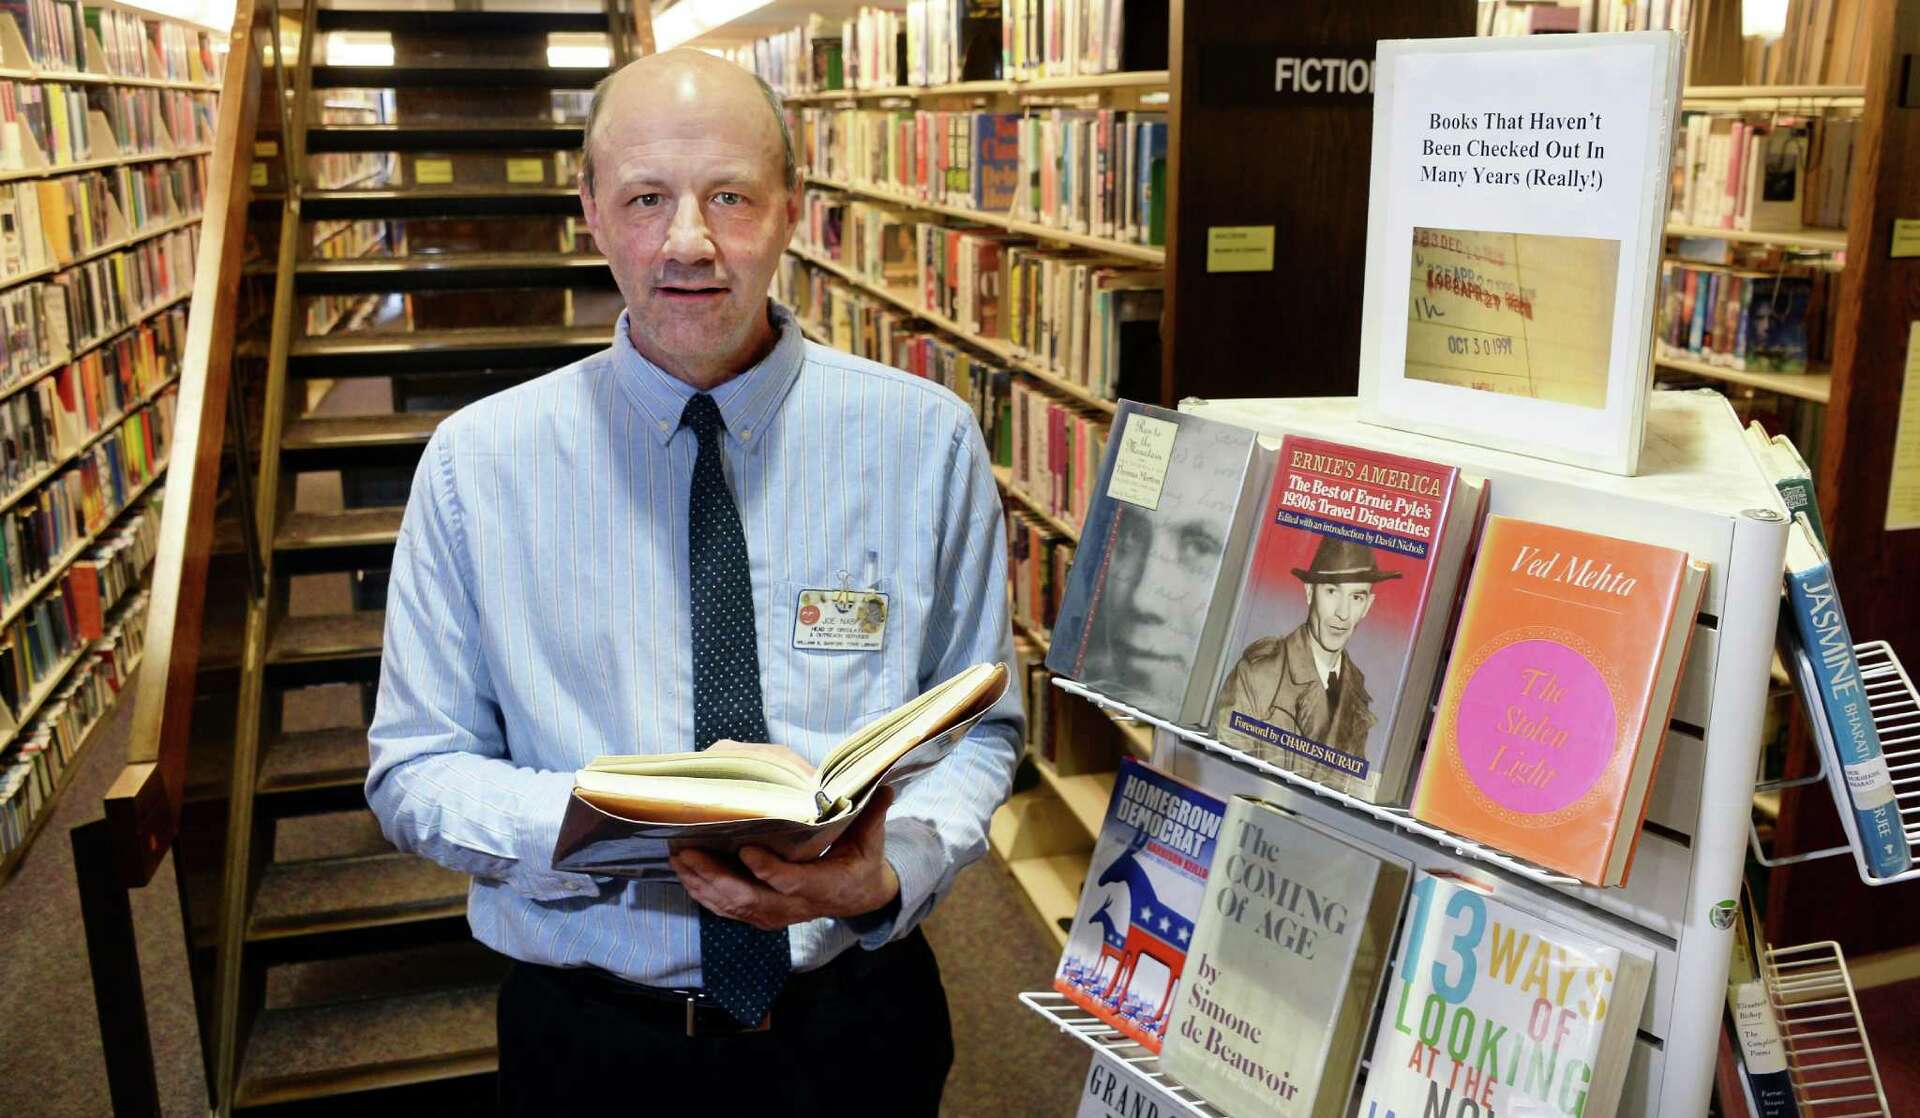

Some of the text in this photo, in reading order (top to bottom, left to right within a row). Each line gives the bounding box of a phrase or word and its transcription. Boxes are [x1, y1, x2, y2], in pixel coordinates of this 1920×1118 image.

[1430, 112, 1602, 130] Books That Haven’t
[1423, 139, 1604, 159] Been Checked Out In
[1420, 166, 1603, 192] Many Years (Really!)
[1448, 335, 1470, 355] OCT
[1289, 475, 1433, 522] The Best of Ernie Pyle’s
[1290, 451, 1441, 497] ERNIE’S AMERICA
[1277, 512, 1425, 555] Edited with an introduction by David Nichols
[1281, 491, 1430, 538] 1930s Travel Dispatches
[1510, 545, 1639, 597] Ved Mehta
[1802, 580, 1860, 701] JASMINE
[1520, 667, 1569, 704] The
[1234, 716, 1364, 774] Foreword by CHARLES KURALT
[1496, 703, 1569, 749] Stolen
[1844, 703, 1871, 760] BHARATI
[1488, 744, 1556, 789] Light
[1116, 799, 1207, 859] DEMOCRAT
[1123, 774, 1221, 839] HOMEGROW
[1238, 820, 1280, 863] The
[1226, 853, 1349, 935] COMING
[1217, 886, 1319, 961] Of AGE
[1399, 875, 1488, 1005] 13
[1198, 953, 1222, 986] by
[1487, 921, 1613, 1022] WAYS
[1188, 983, 1262, 1045] Simone
[1527, 997, 1577, 1050] OF
[1180, 1014, 1203, 1045] de
[1204, 1027, 1299, 1103] Beauvoir
[1394, 980, 1592, 1118] LOOKING
[1408, 1040, 1441, 1079] AT
[1449, 1059, 1498, 1111] THE
[1089, 1063, 1159, 1118] GRAND
